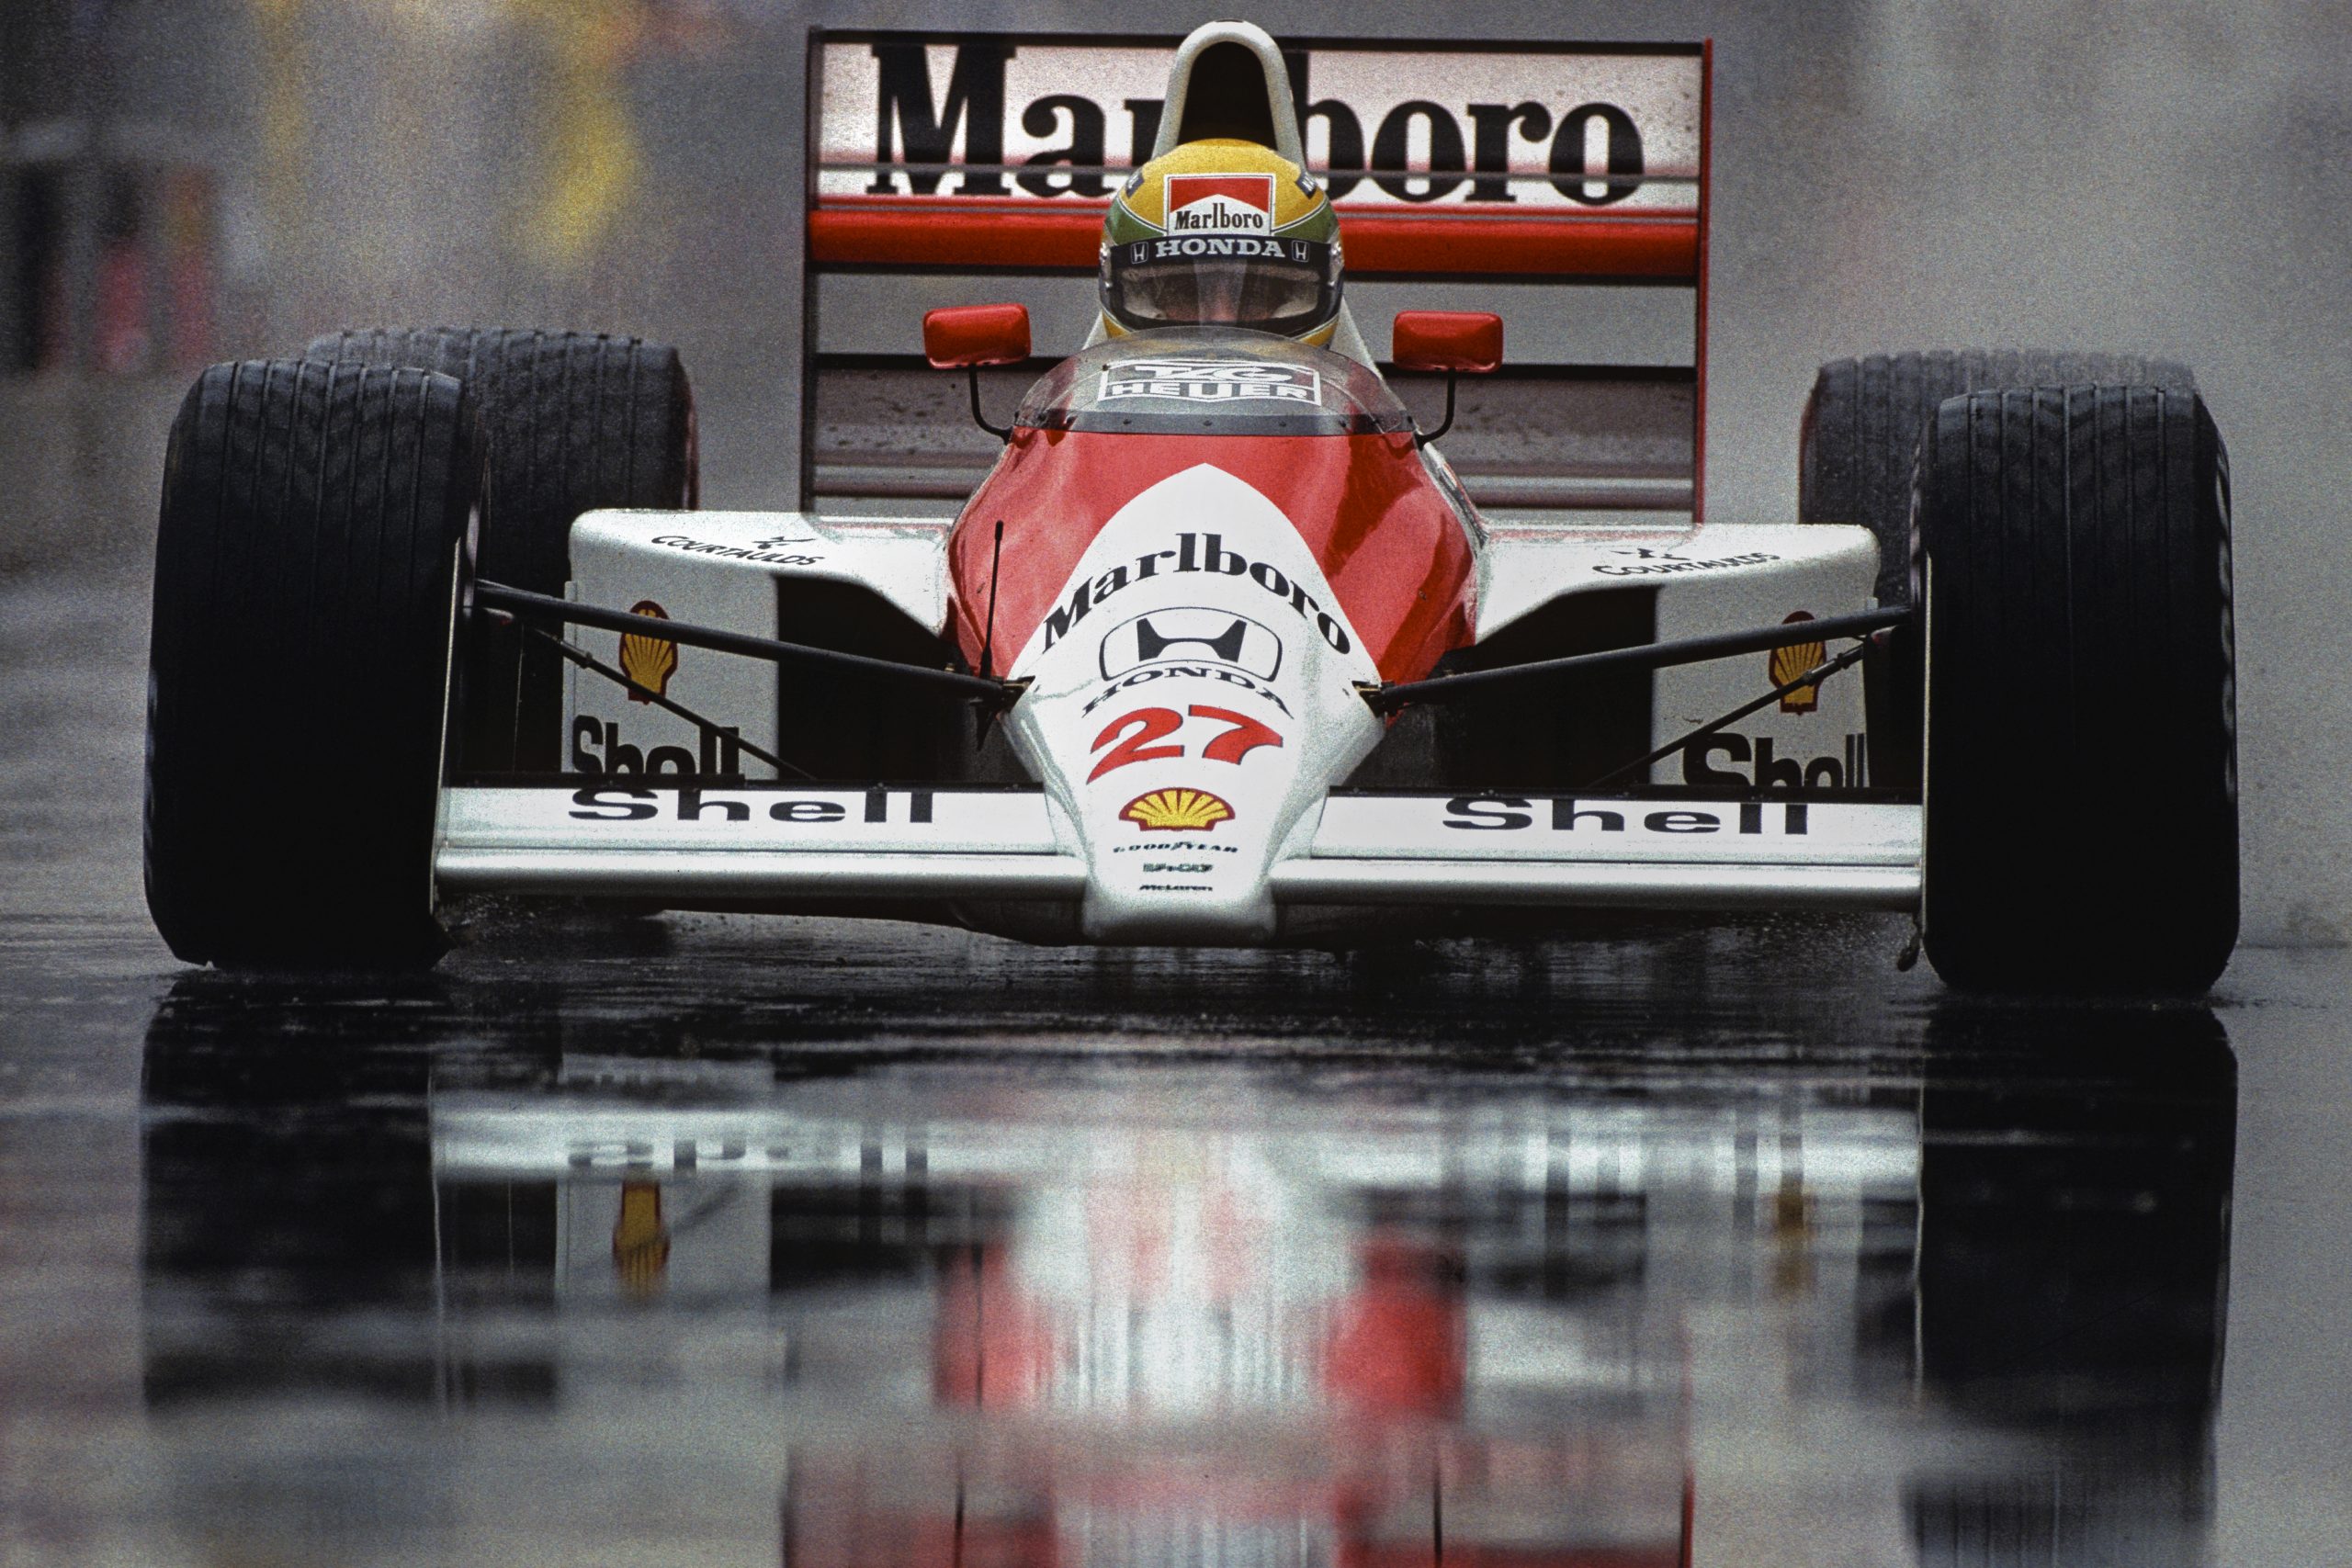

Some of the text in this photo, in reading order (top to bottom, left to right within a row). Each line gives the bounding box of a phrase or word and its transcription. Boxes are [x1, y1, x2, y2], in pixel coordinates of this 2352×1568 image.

[867, 44, 1644, 206] Maboro
[1174, 202, 1263, 230] Marlboro
[1155, 238, 1285, 259] HONDA
[1111, 382, 1308, 400] HEUER
[1042, 533, 1351, 655] Marlboro
[1081, 666, 1295, 719] HONDA
[1085, 704, 1283, 785] 27
[569, 786, 933, 823] Shell
[1442, 796, 1809, 835] Shell
